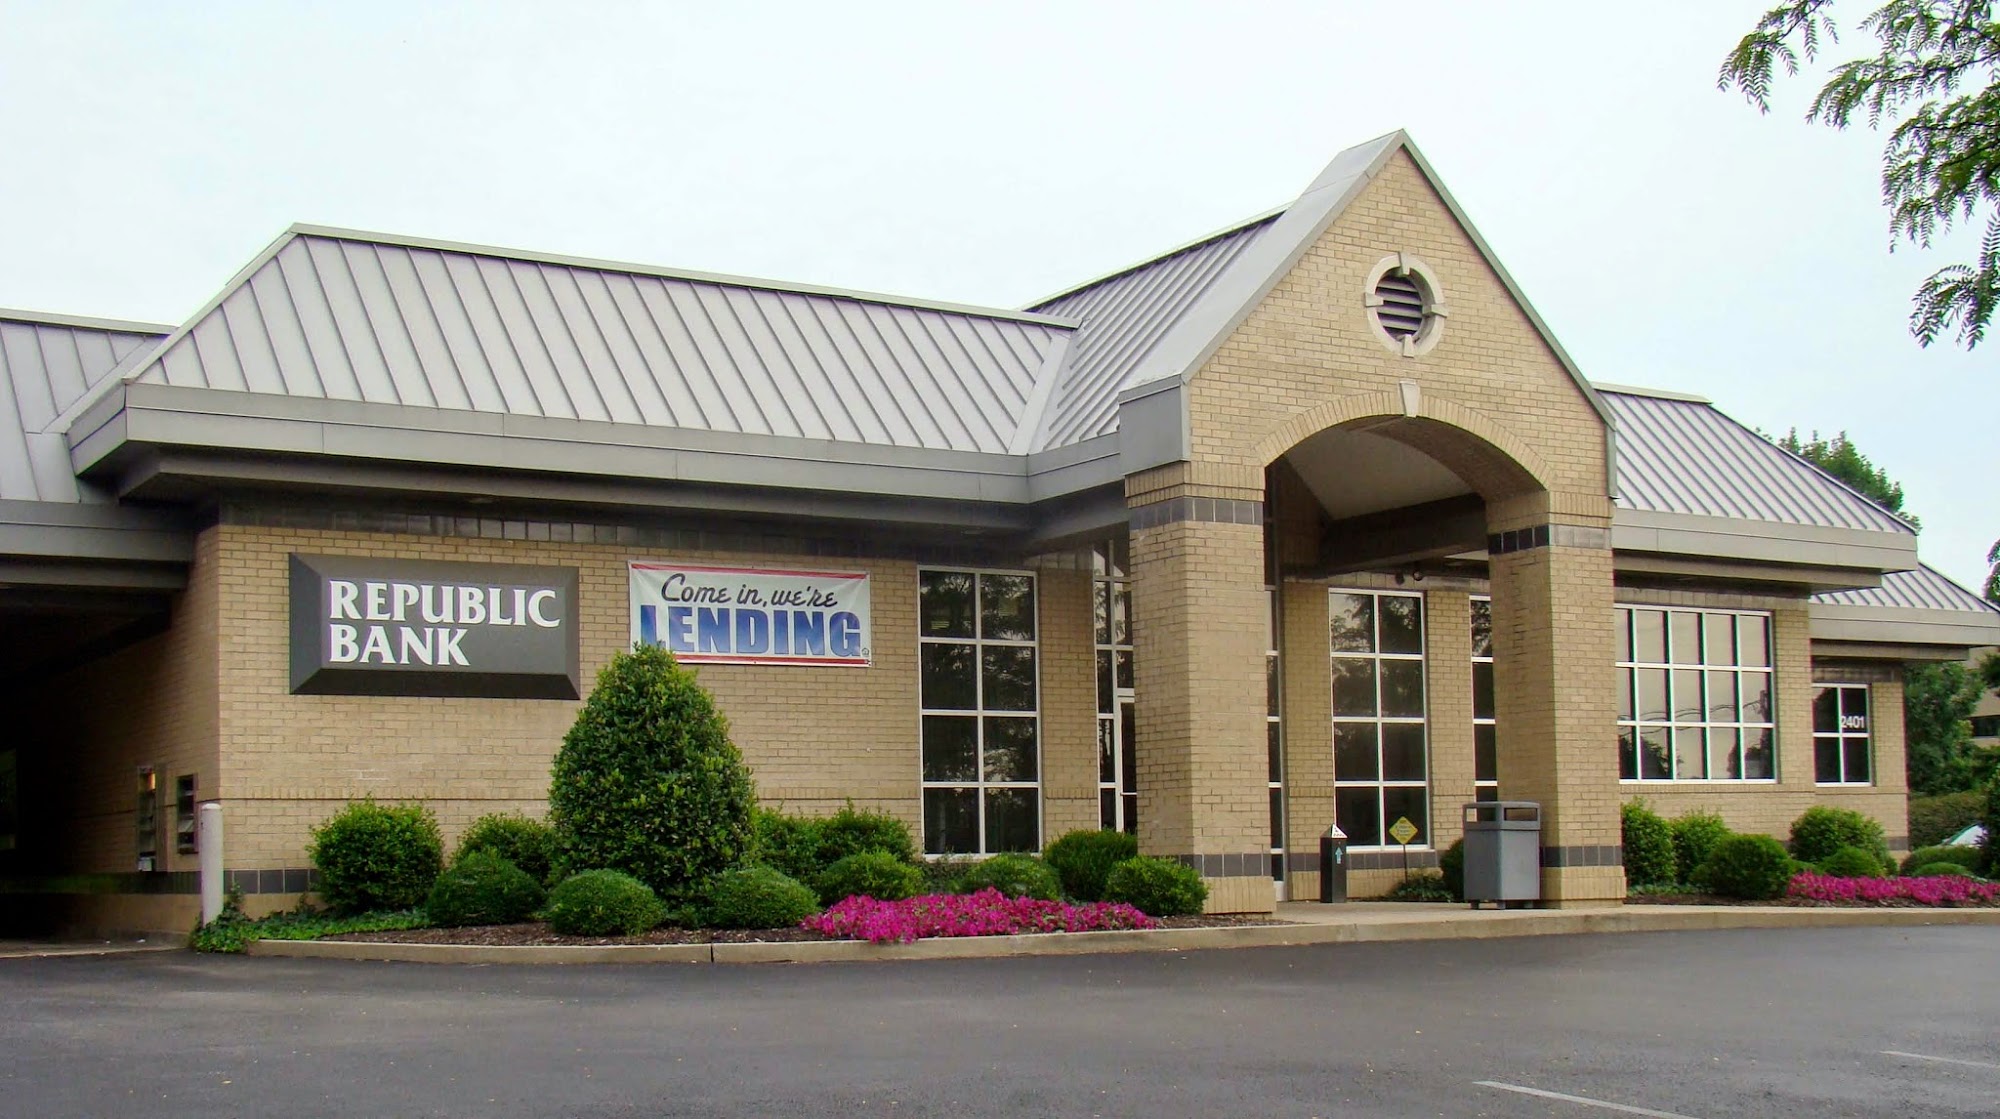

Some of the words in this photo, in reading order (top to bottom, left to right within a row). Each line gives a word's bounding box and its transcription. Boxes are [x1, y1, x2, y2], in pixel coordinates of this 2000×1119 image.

[329, 580, 560, 628] REPUBLIC
[661, 573, 731, 604] Come
[737, 584, 768, 608] in,
[771, 586, 838, 608] we're
[329, 624, 471, 666] BANK
[640, 604, 861, 657] LENDING
[1841, 715, 1865, 729] 2401
